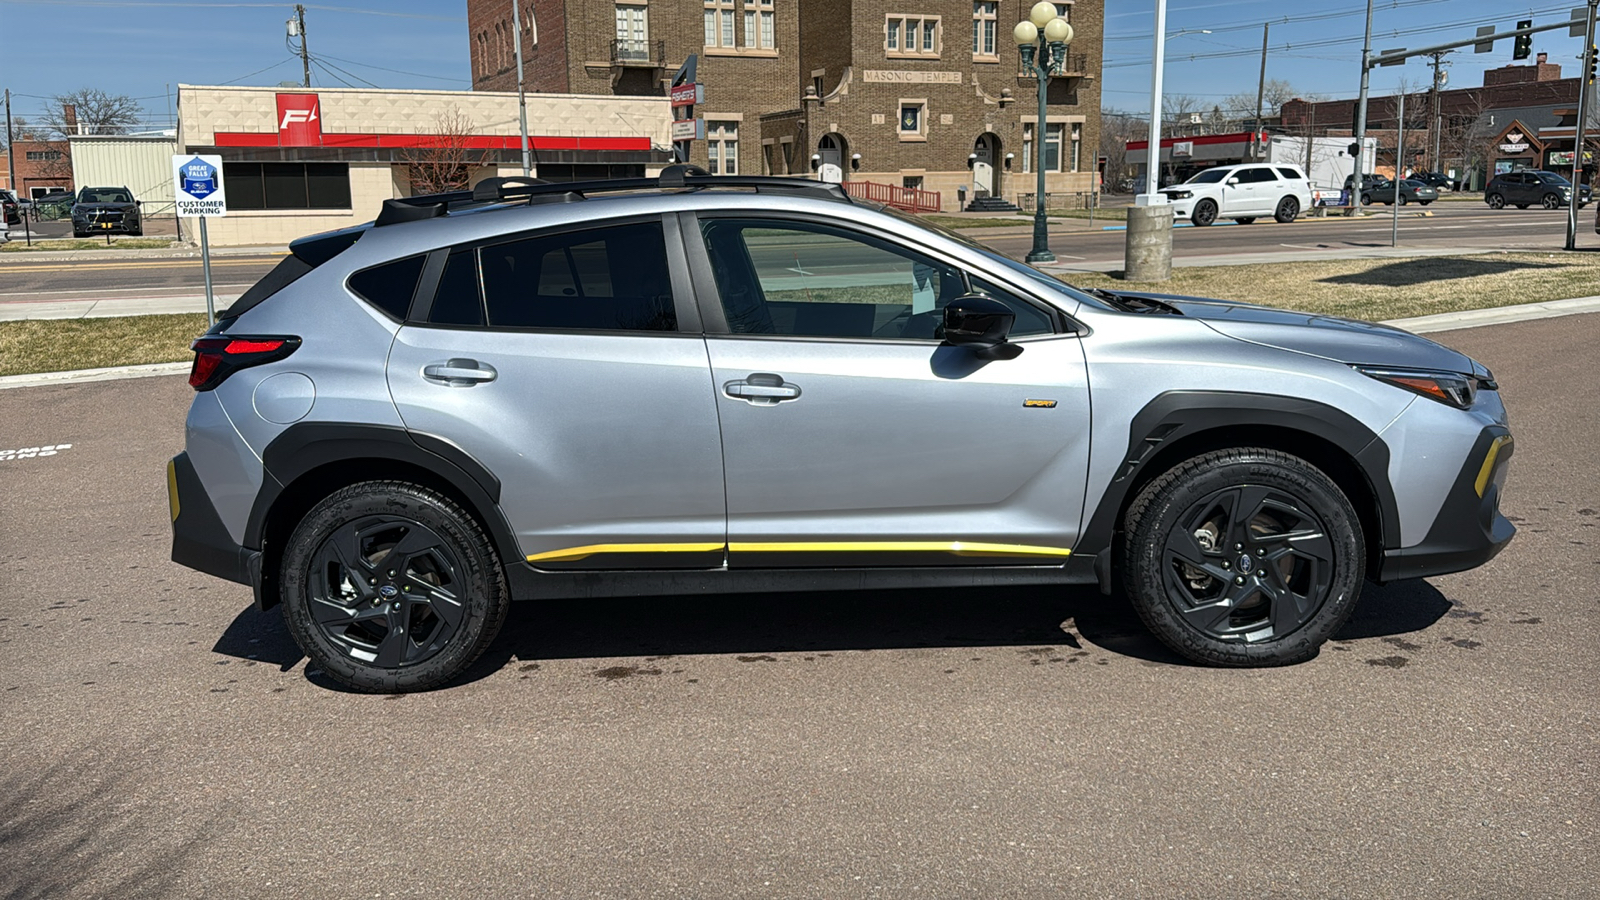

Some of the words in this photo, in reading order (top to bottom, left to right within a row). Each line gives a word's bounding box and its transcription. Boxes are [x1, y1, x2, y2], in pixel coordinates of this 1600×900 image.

[865, 71, 913, 81] MASONIC
[919, 72, 960, 82] TEMPLE
[177, 200, 224, 208] CUSTOMER
[182, 207, 221, 215] PARKING
